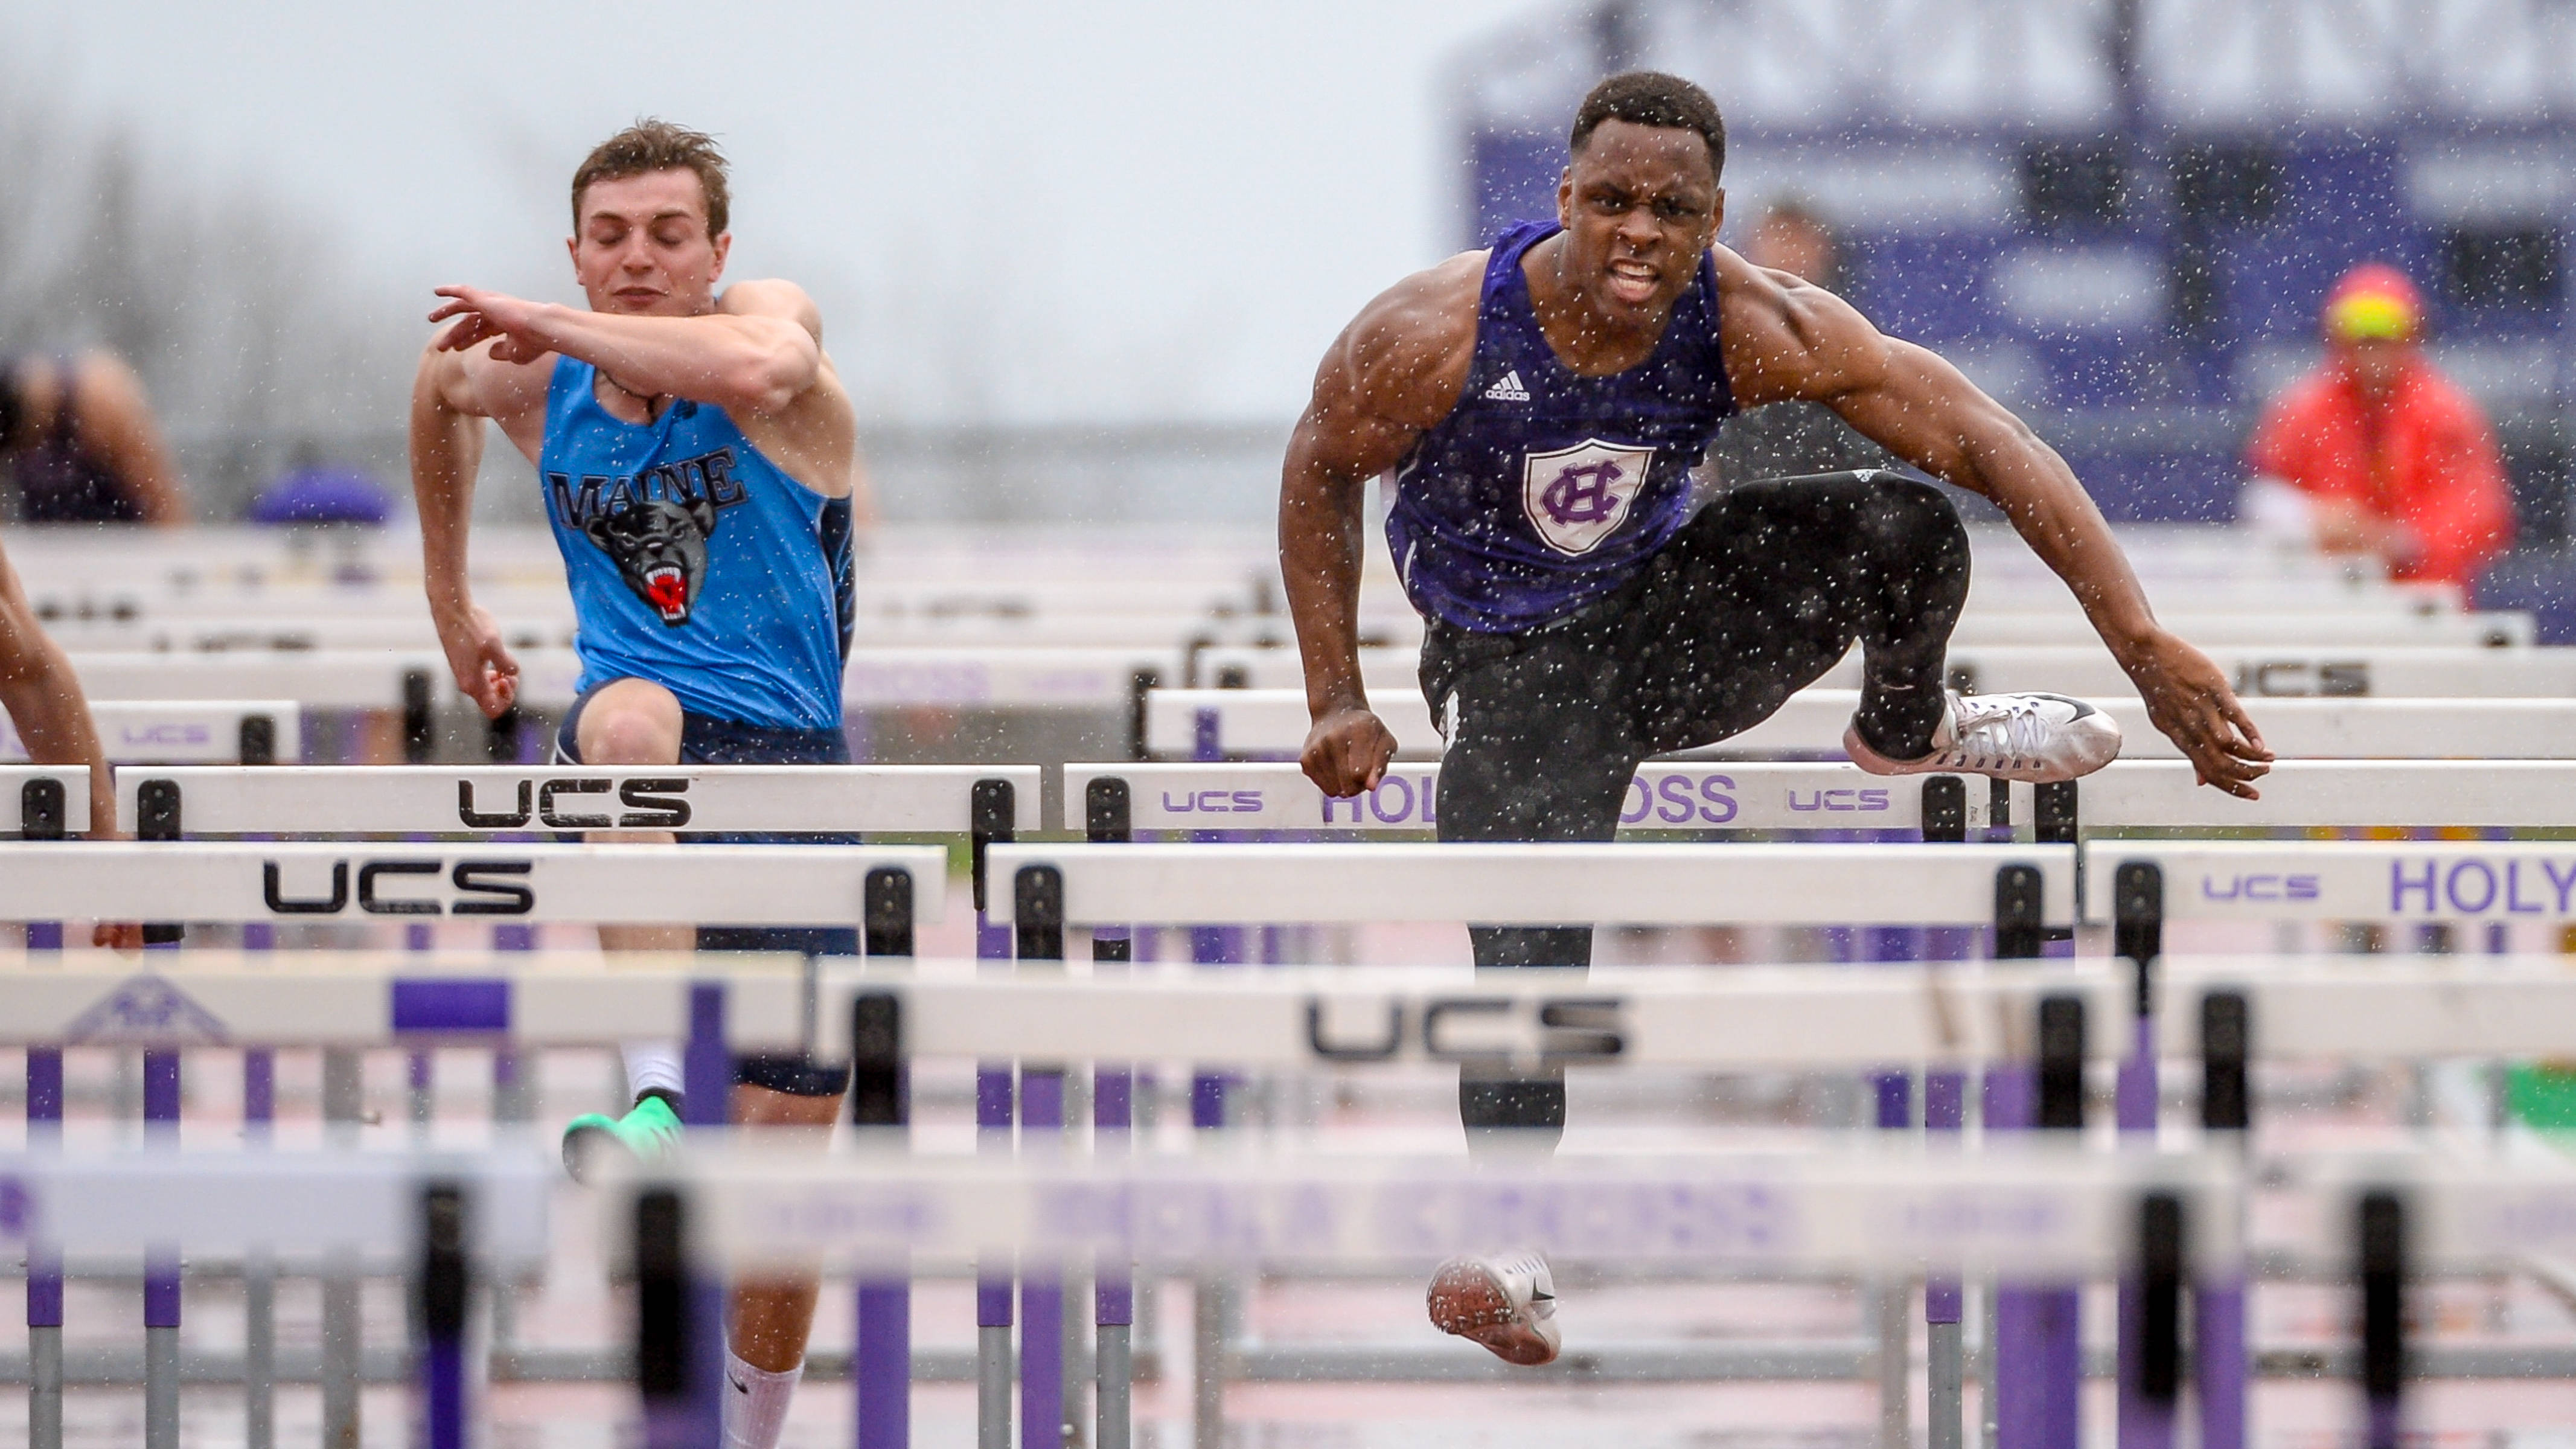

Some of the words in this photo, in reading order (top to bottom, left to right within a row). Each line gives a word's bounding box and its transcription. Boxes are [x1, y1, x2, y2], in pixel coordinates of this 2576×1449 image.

[1485, 389, 1530, 401] adidas
[546, 446, 748, 529] MAINE
[458, 778, 692, 828] UCS
[1163, 791, 1264, 812] UCS
[1323, 775, 1436, 823] HOL
[1789, 789, 1890, 811] UCS
[263, 859, 535, 915] UCS
[2202, 875, 2321, 900] UCS
[2391, 856, 2576, 913] HOLY
[1304, 995, 1626, 1061] UCS
